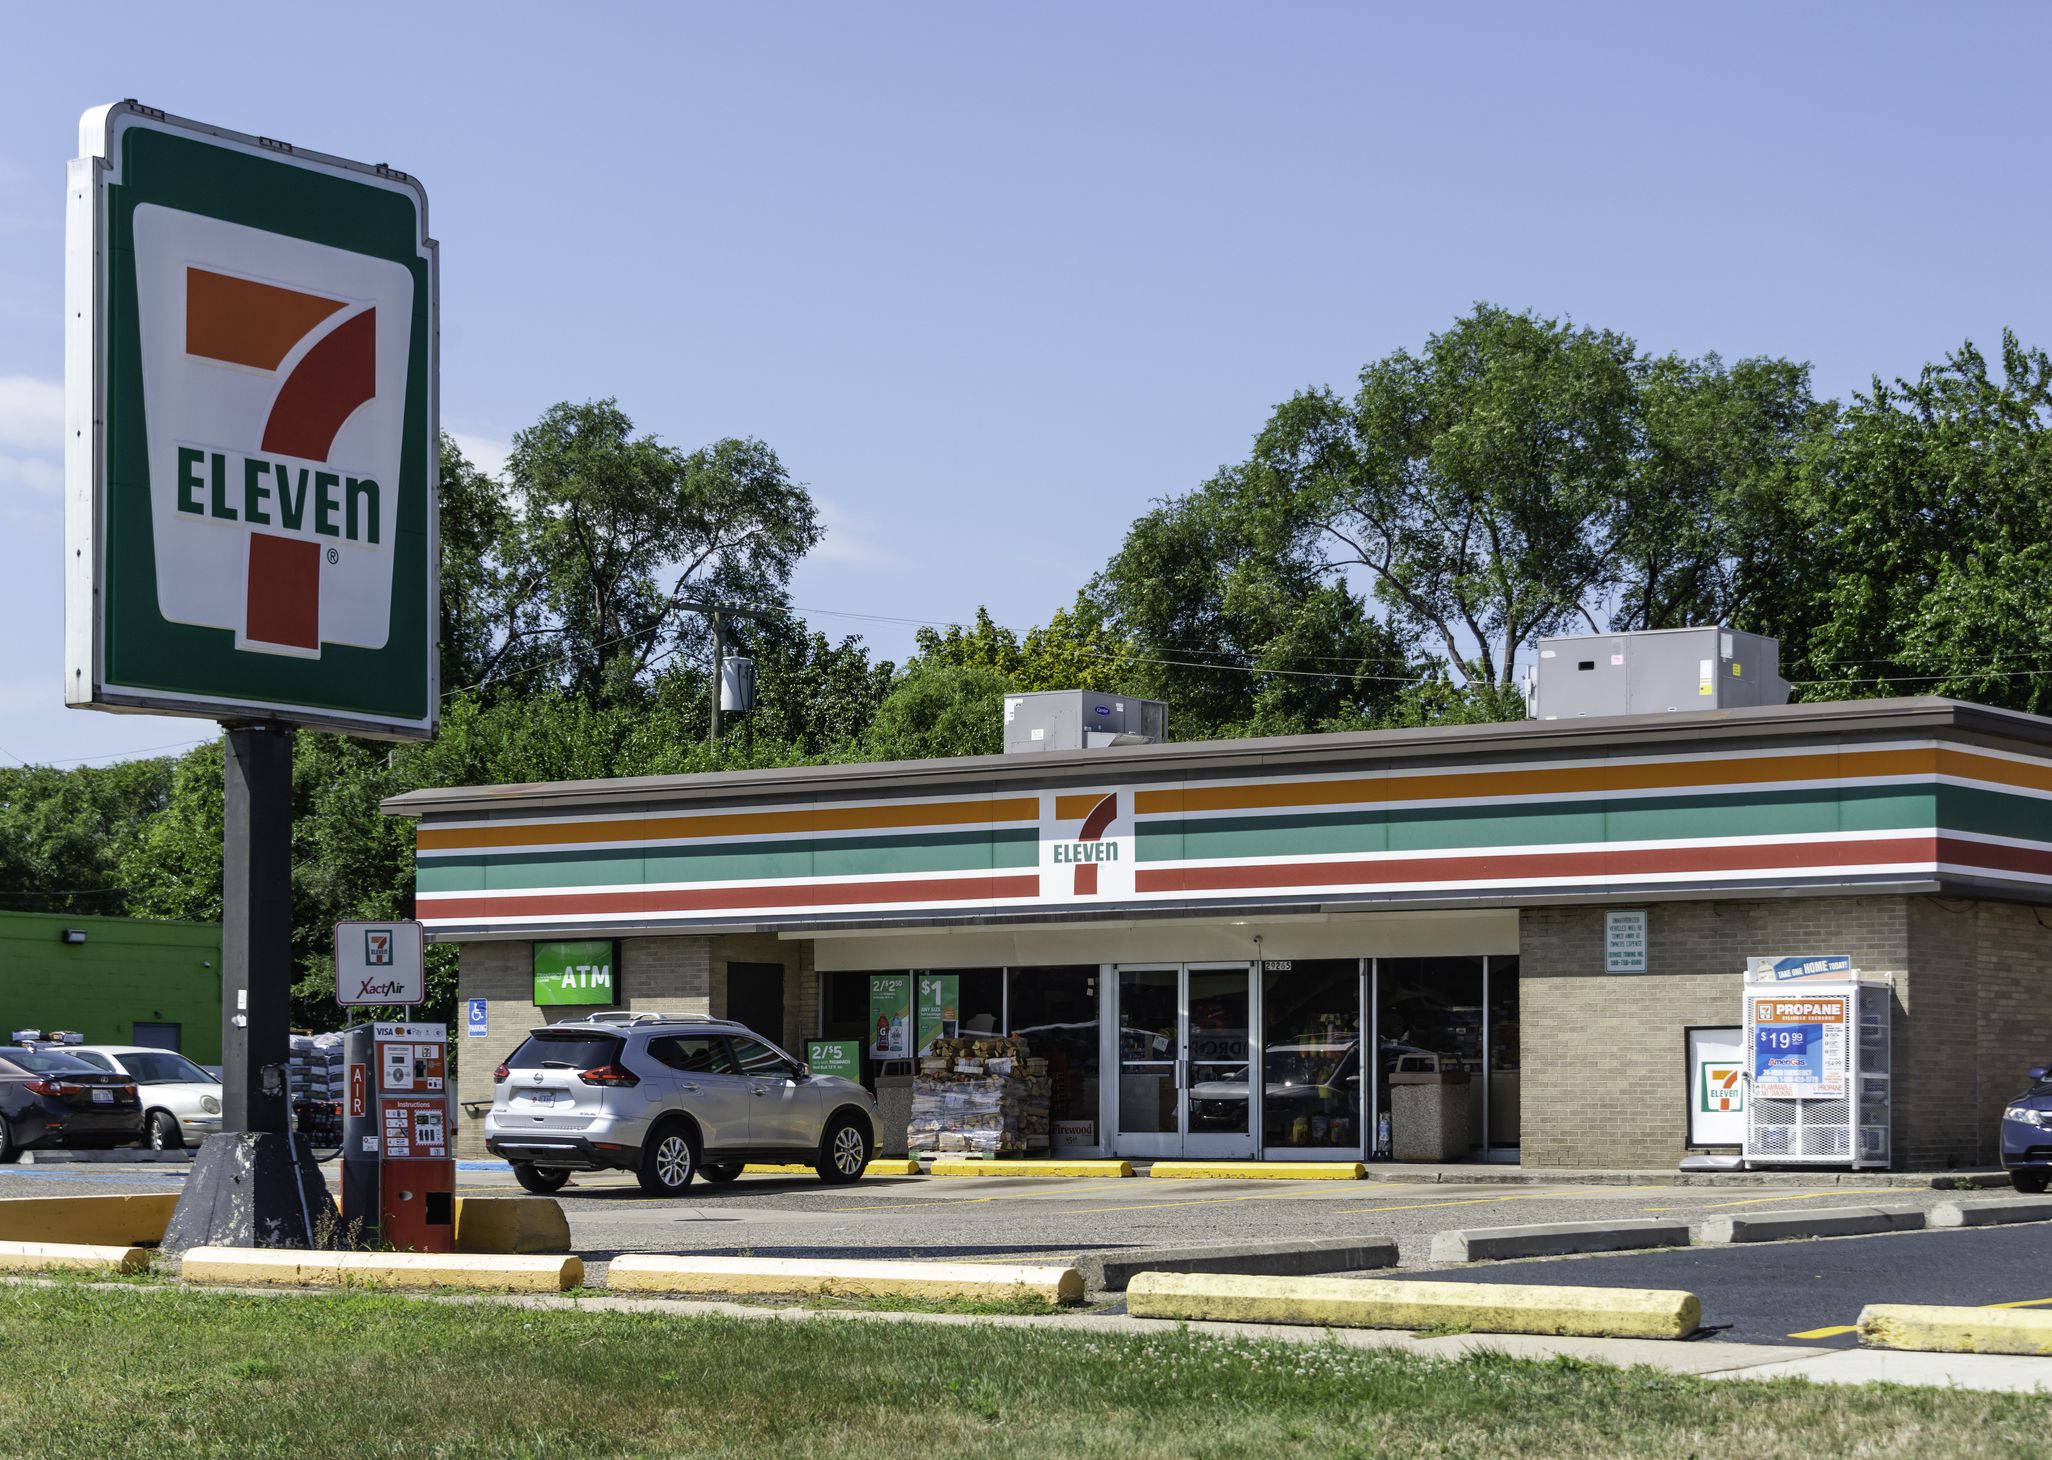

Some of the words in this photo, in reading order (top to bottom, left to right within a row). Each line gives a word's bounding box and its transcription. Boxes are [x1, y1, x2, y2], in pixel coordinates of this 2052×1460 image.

[187, 266, 376, 649] 7
[1055, 792, 1117, 895] 7
[561, 965, 610, 989] ATM
[1778, 970, 1792, 979] TAKE
[1792, 967, 1803, 976] ONE
[1803, 960, 1828, 974] HOME
[356, 976, 405, 999] XactAir
[921, 979, 942, 1006] $1
[1776, 1003, 1841, 1015] PROPANE
[376, 1027, 394, 1036] VISA
[353, 1068, 362, 1112] AIR
[1711, 1070, 1738, 1110] 7
